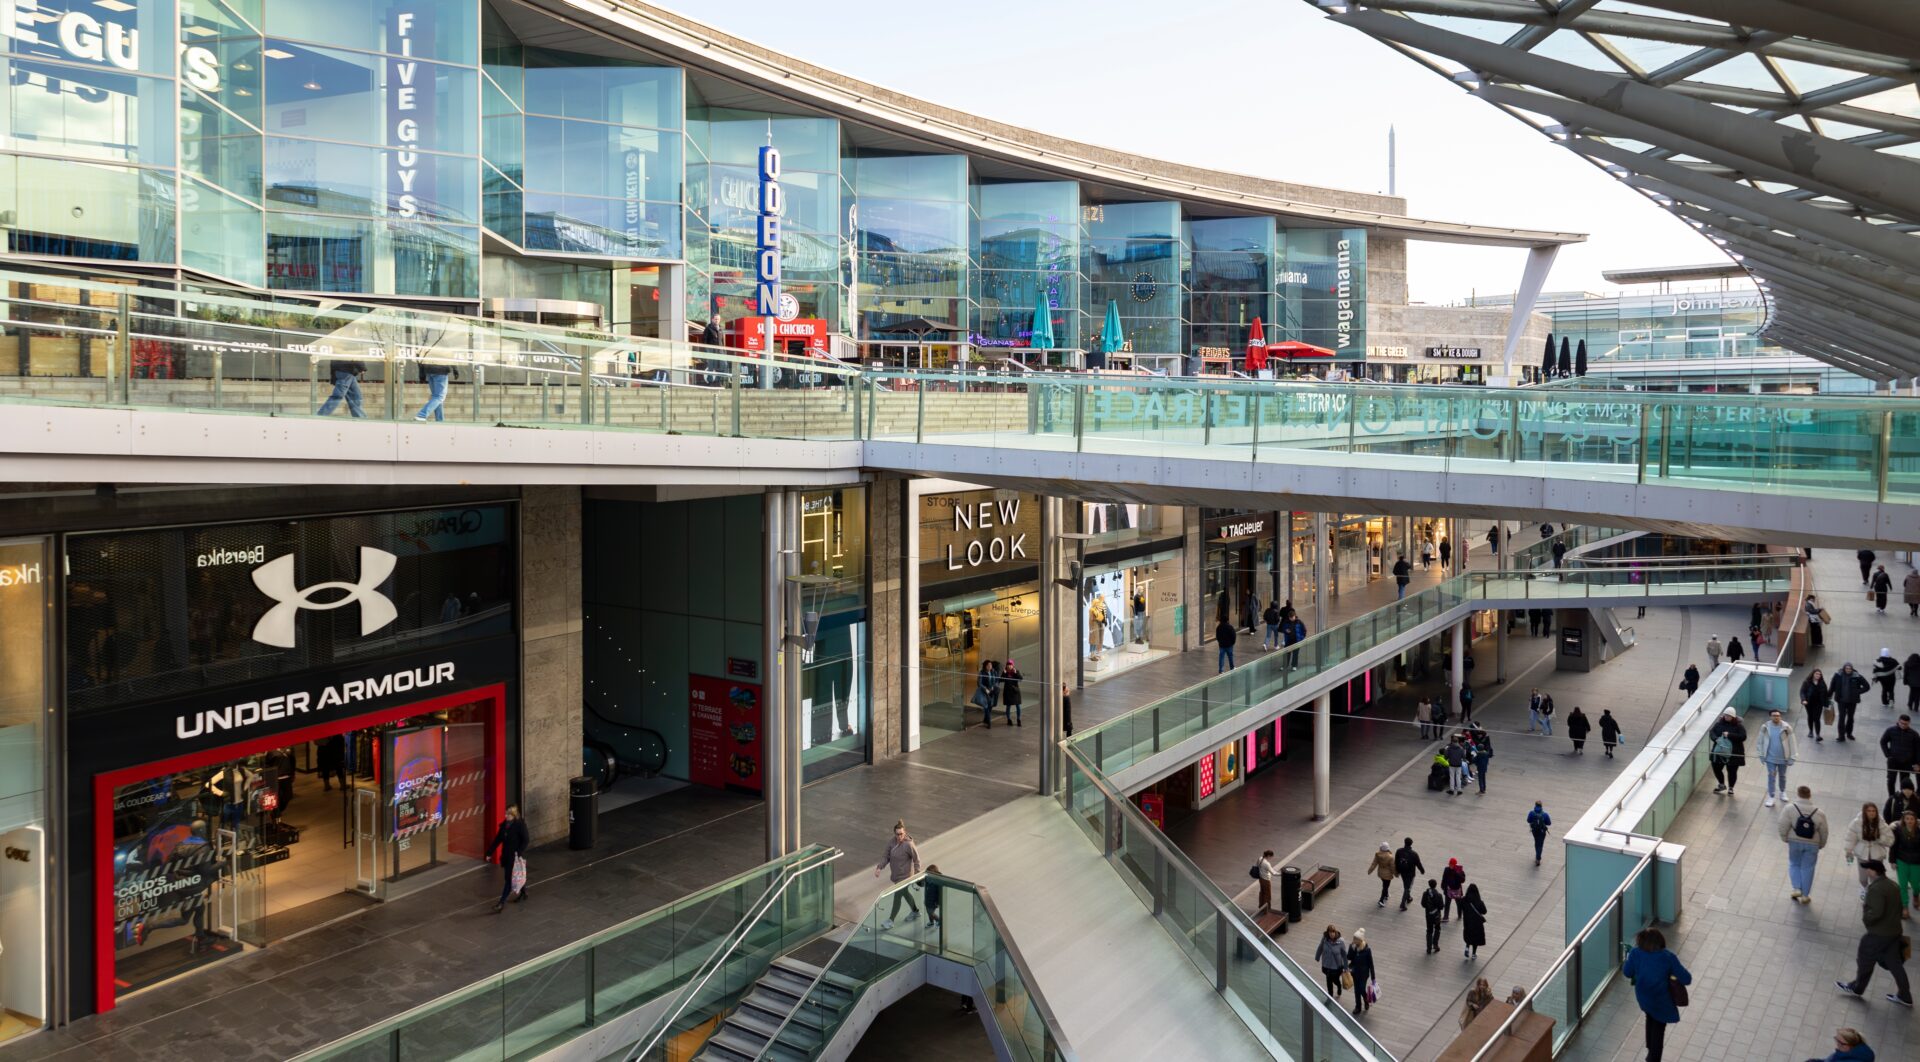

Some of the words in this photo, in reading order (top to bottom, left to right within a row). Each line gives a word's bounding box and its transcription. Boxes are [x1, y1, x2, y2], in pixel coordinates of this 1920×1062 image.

[57, 11, 221, 93] GUS
[397, 13, 417, 110] FIVE
[397, 118, 418, 218] GUYS
[761, 148, 781, 314] ODEON
[1338, 239, 1354, 348] wagamama
[1672, 295, 1713, 316] John
[779, 323, 815, 336] CHICKENS
[1366, 346, 1375, 357] ON
[1375, 346, 1388, 357] THE
[1388, 346, 1408, 357] GREEN
[1456, 348, 1461, 357] &
[1461, 348, 1478, 357] DOUGH
[955, 499, 1020, 532] NEW
[948, 533, 1026, 571] LOOK
[991, 603, 1009, 611] Hello
[176, 691, 310, 740] UNDER
[316, 661, 455, 711] ARMOUR
[118, 875, 167, 898] COLD'S
[118, 892, 141, 909] GOT
[141, 874, 202, 901] NOTHING
[118, 906, 133, 918] ON
[138, 897, 158, 912] YOU
